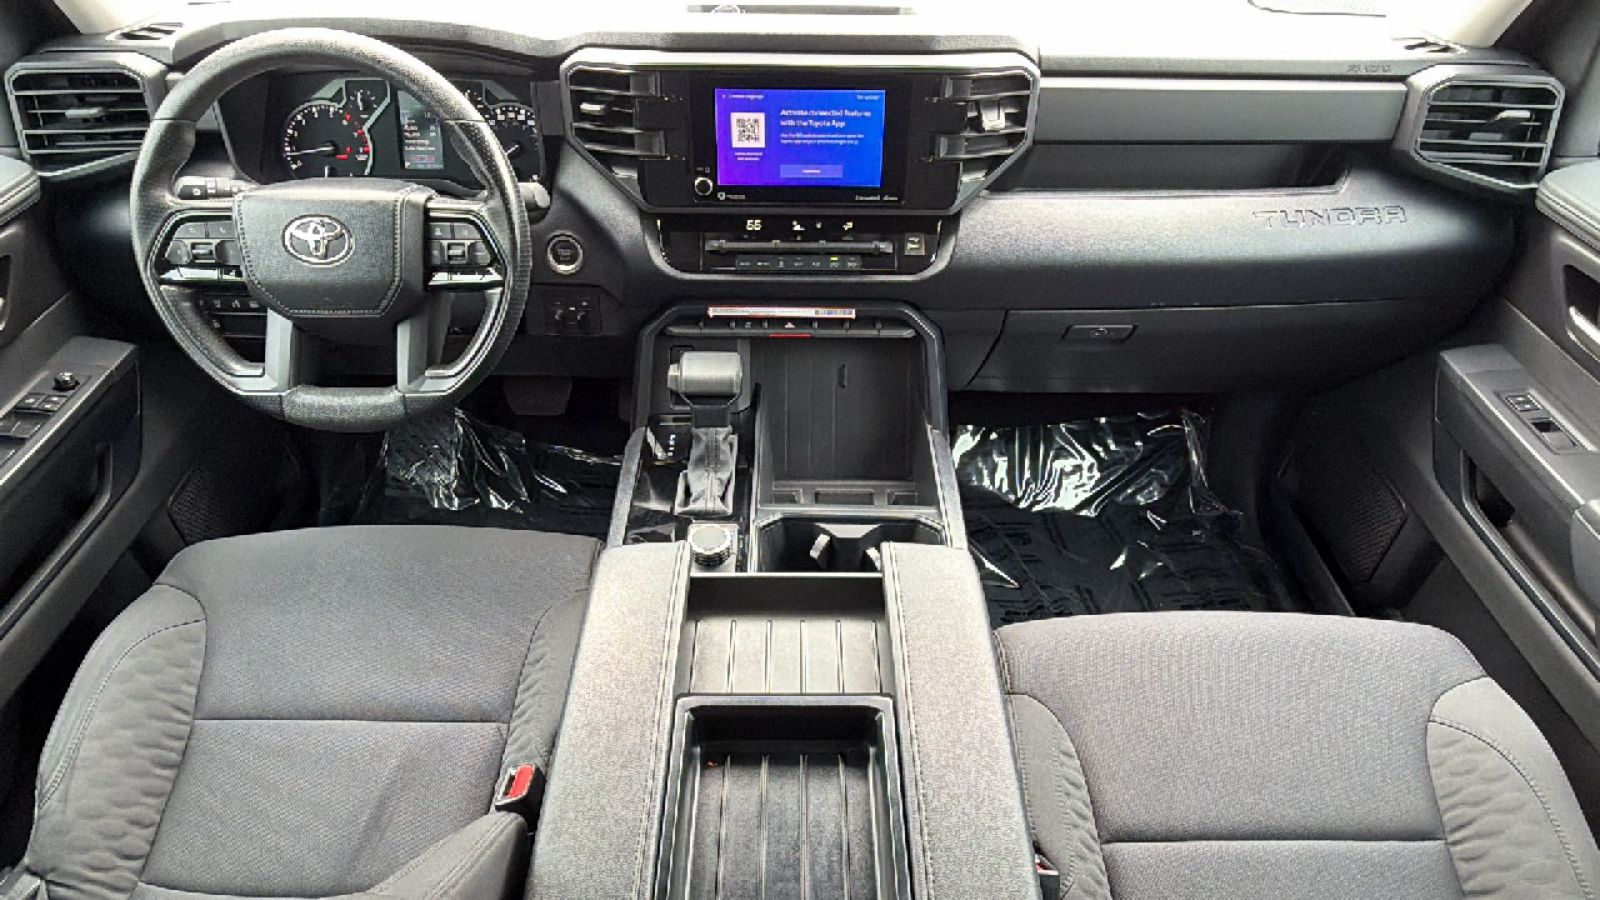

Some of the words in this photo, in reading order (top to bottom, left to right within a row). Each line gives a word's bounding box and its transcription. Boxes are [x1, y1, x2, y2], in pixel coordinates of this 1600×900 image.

[844, 109, 871, 117] features
[809, 119, 830, 128] Toyota
[831, 119, 846, 128] App
[1252, 205, 1407, 229] TUNDRA
